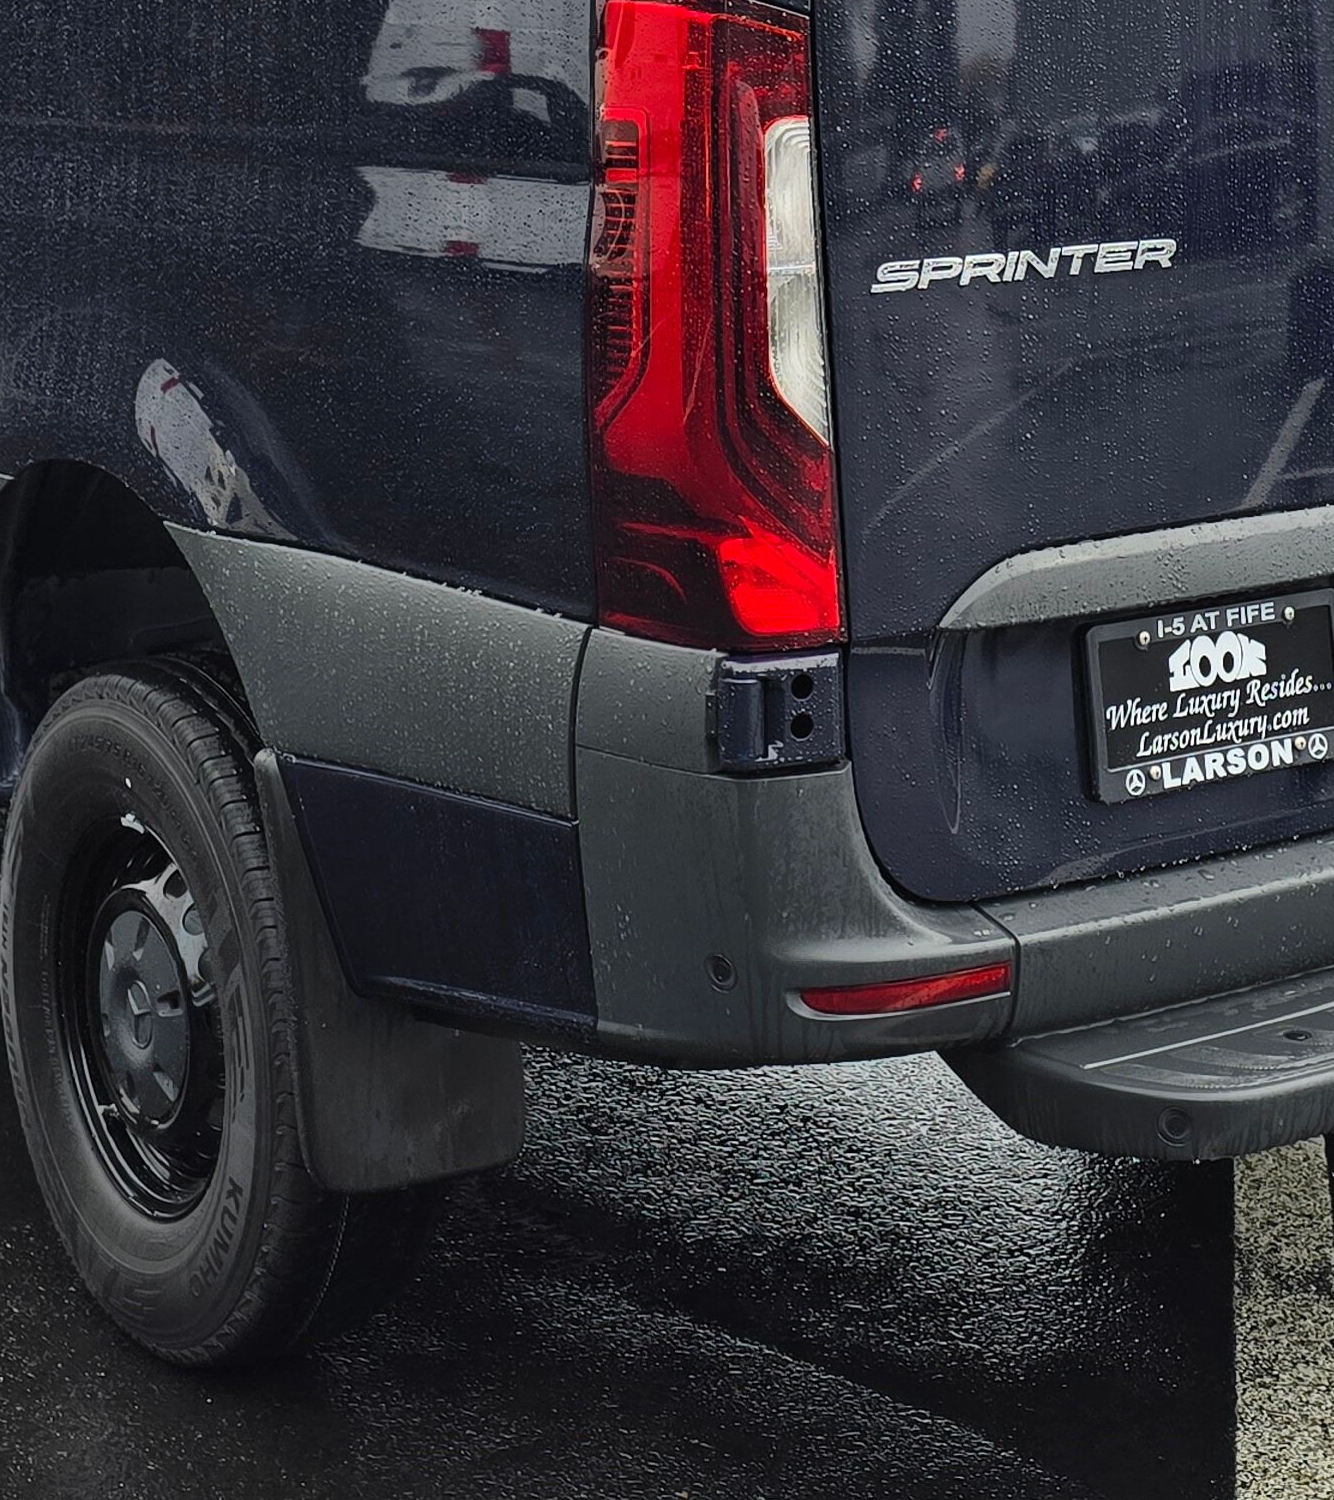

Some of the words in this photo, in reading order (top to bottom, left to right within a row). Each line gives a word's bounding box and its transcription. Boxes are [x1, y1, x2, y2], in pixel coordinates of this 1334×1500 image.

[870, 238, 1177, 294] SPRINTER
[1157, 617, 1185, 639] I-5
[1190, 611, 1219, 633] AT
[1226, 602, 1276, 628] FIFE
[1106, 698, 1169, 731] Where
[1172, 688, 1241, 719] Luxury
[1245, 668, 1332, 707] Resides...
[1136, 706, 1310, 759] LarsonLuxury.com
[1161, 738, 1295, 790] LARSON
[189, 1176, 244, 1297] KUMHO
